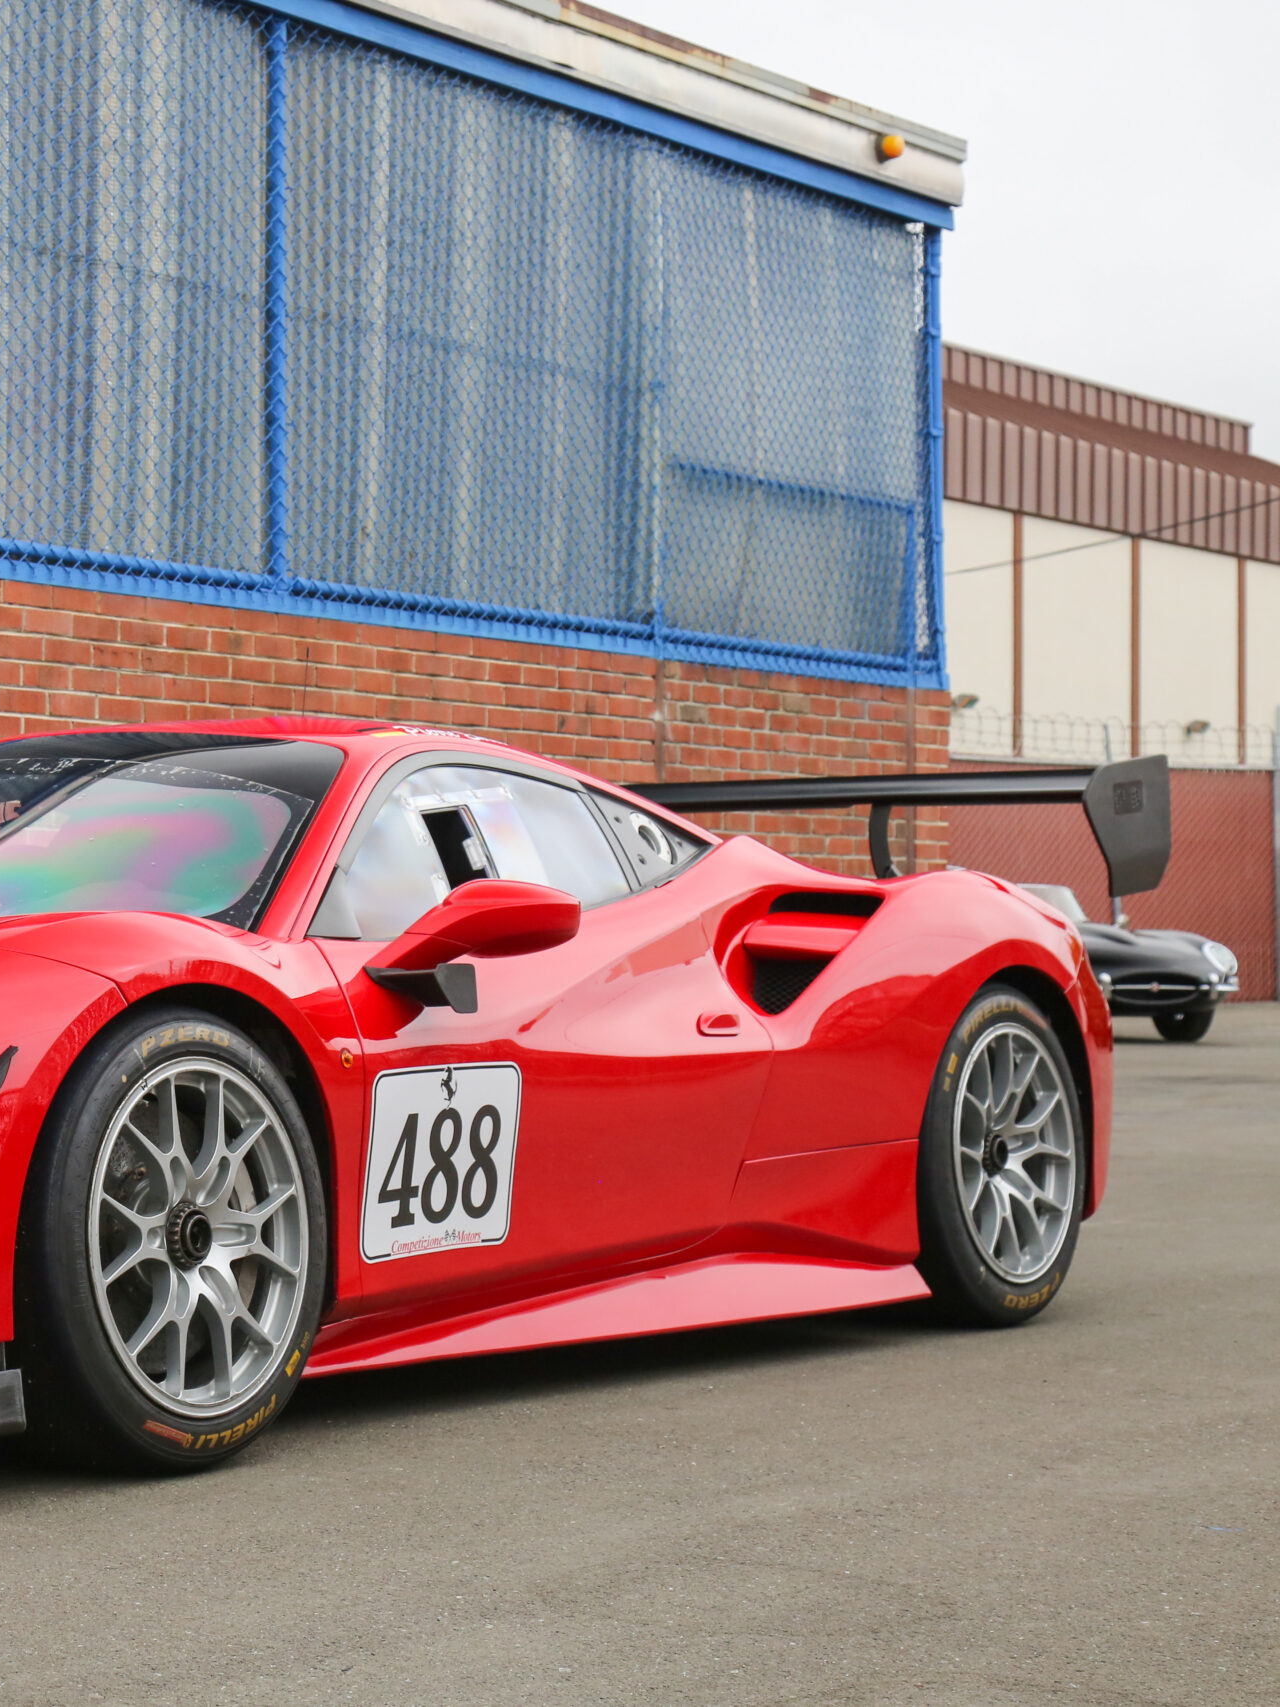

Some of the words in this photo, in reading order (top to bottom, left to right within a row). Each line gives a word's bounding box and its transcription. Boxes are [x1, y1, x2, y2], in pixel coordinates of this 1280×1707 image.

[378, 1104, 501, 1228] 488
[391, 1234, 444, 1254] Competizione
[456, 1230, 481, 1242] Motors
[195, 1394, 277, 1449] PIRELLI
